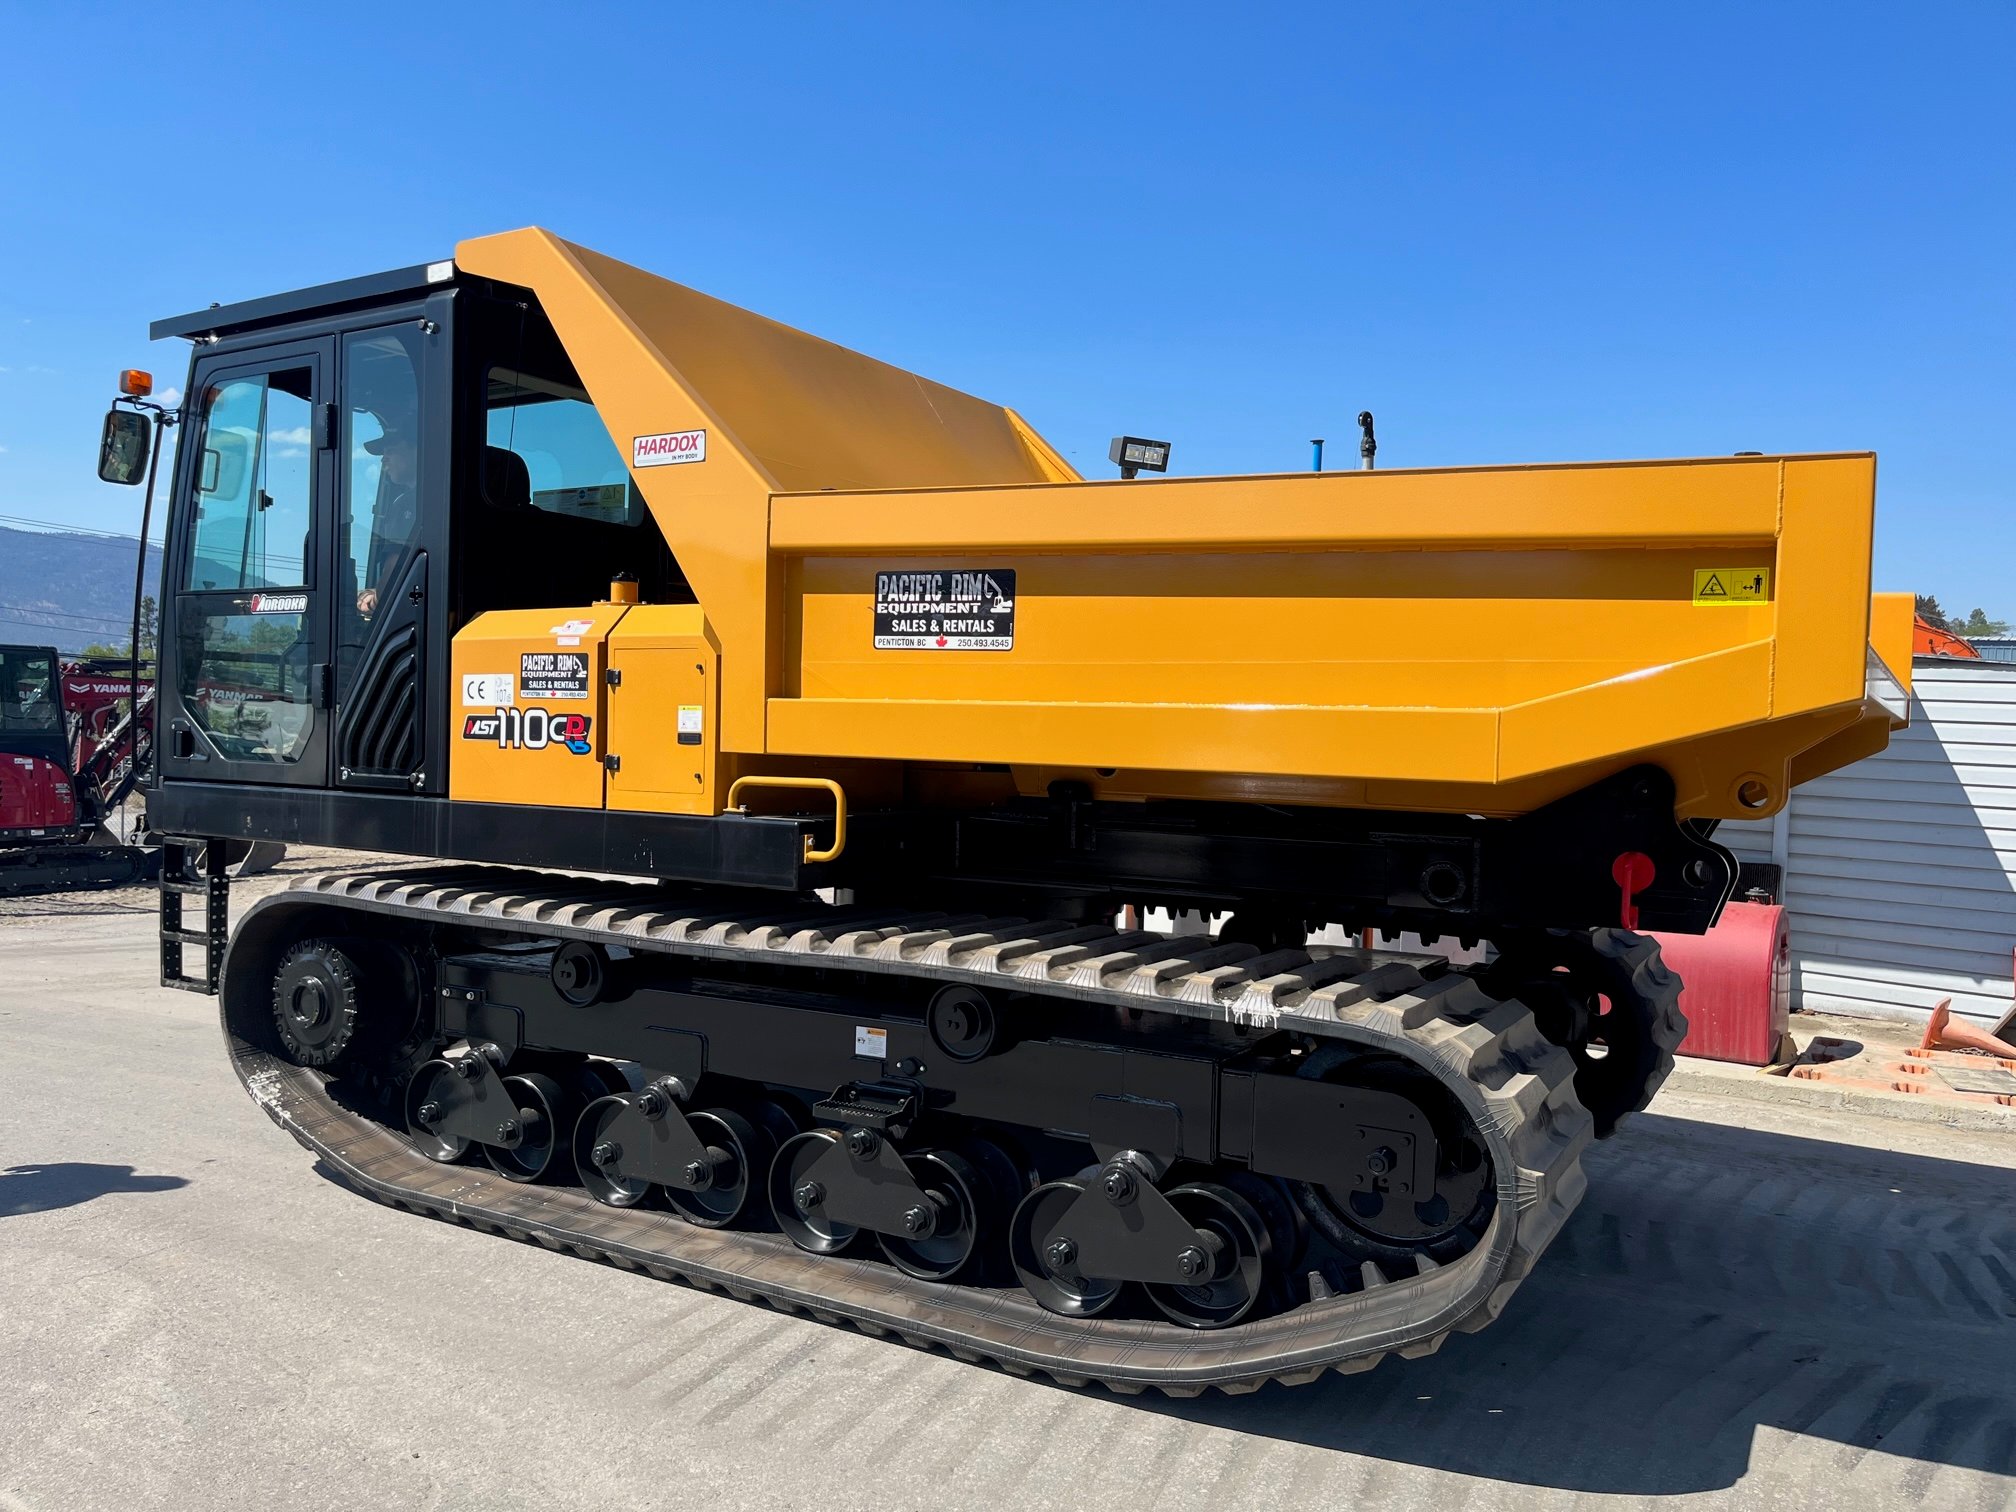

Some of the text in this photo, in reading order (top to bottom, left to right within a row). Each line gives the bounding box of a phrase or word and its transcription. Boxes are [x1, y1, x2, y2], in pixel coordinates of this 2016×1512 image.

[637, 434, 699, 456] HARDOX
[878, 573, 982, 602] PACIFIC RIM
[877, 602, 981, 615] EQUIPMENT
[892, 619, 926, 632] SALES
[930, 619, 939, 632] &
[943, 619, 994, 632] RENTALS
[878, 638, 926, 646] PENTICTON BC
[957, 639, 1009, 647] 250.493.4545
[522, 655, 573, 670] PACIFIC RIM
[467, 681, 485, 700] CE
[528, 681, 579, 689] SALES & RENTALS
